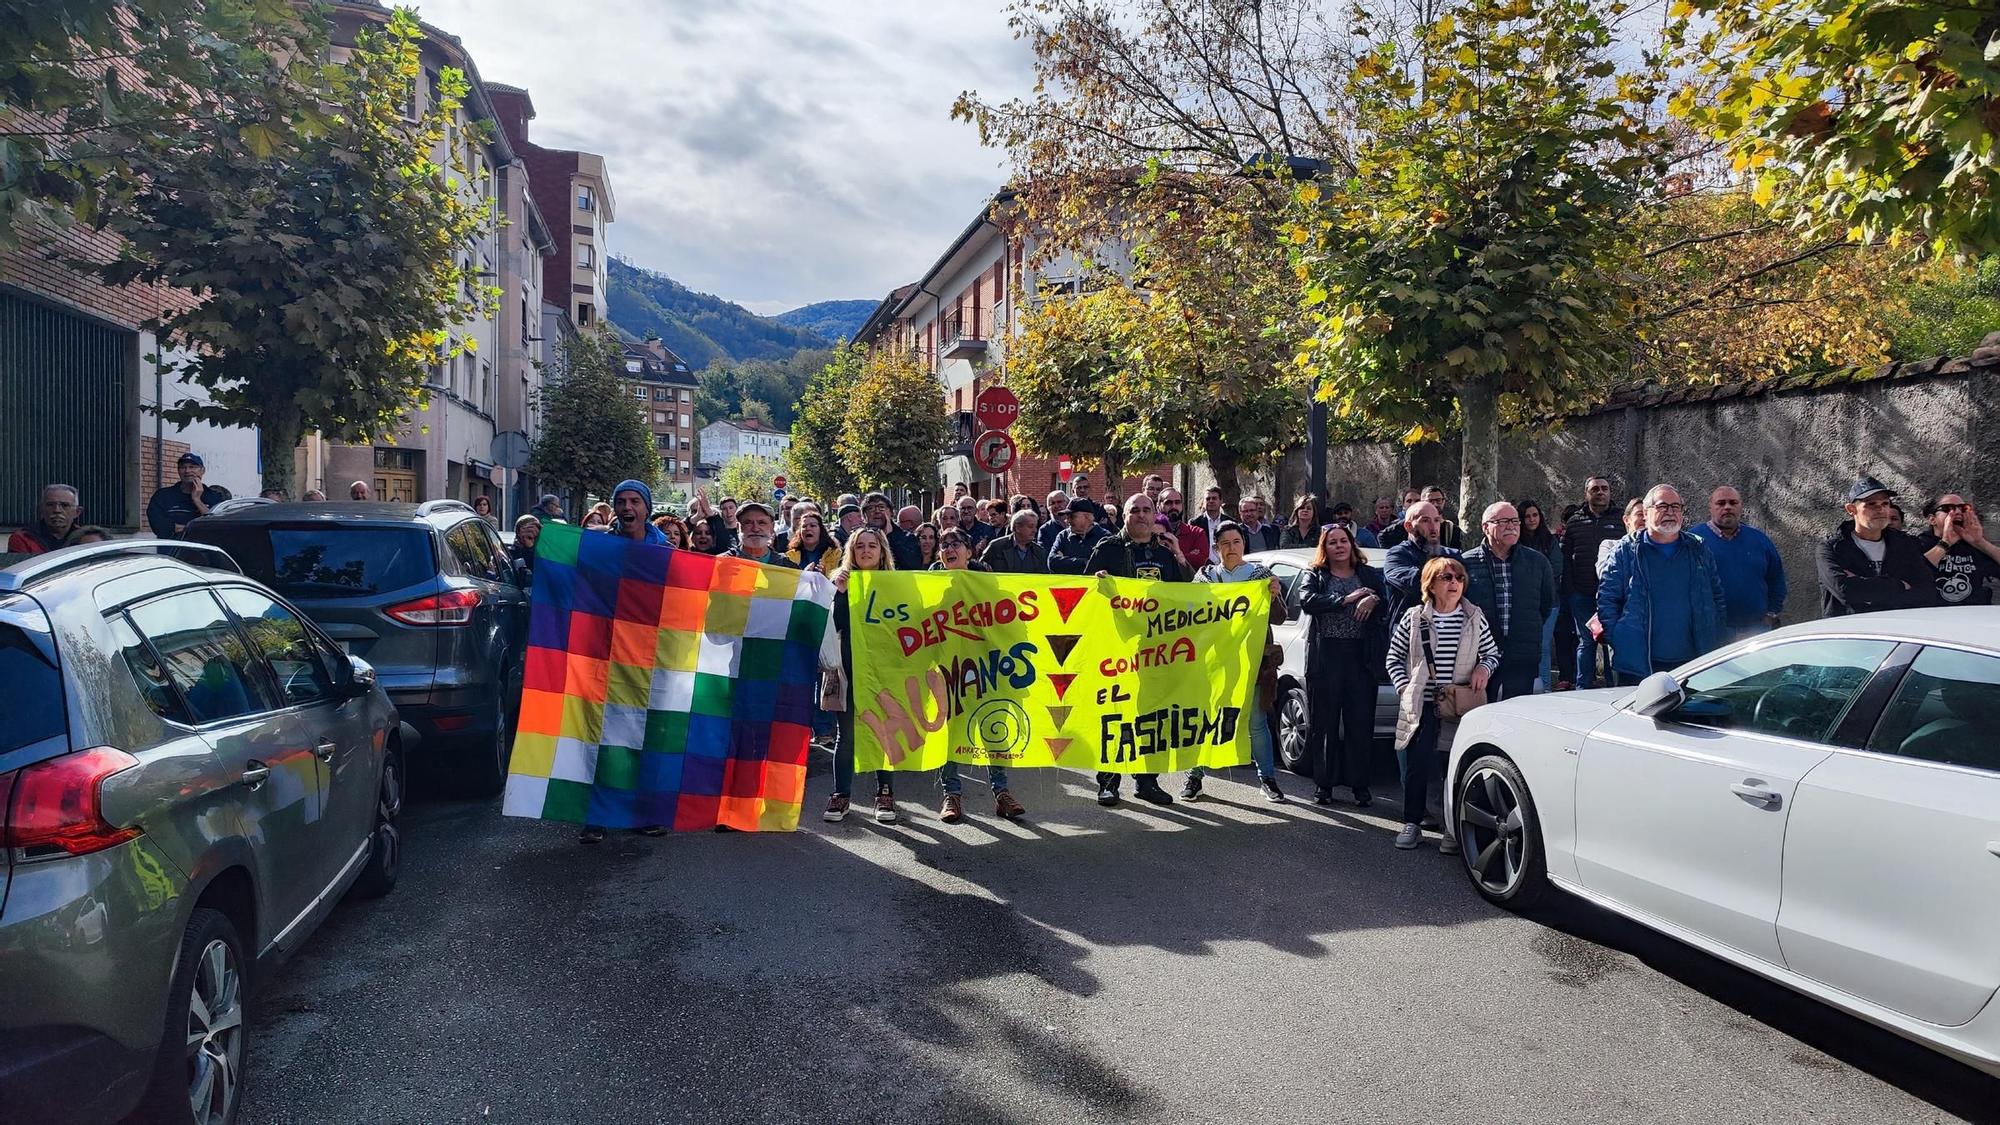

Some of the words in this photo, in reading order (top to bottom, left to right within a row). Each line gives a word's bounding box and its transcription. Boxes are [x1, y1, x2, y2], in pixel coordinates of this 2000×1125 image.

[980, 402, 1016, 414] STOP
[1110, 595, 1159, 613] COMO
[897, 590, 1039, 657] DERECHOS
[1099, 637, 1196, 677] CONTRA
[859, 642, 1038, 766] HUMANOS
[1096, 684, 1131, 705] EL
[955, 745, 986, 755] ABRAZO
